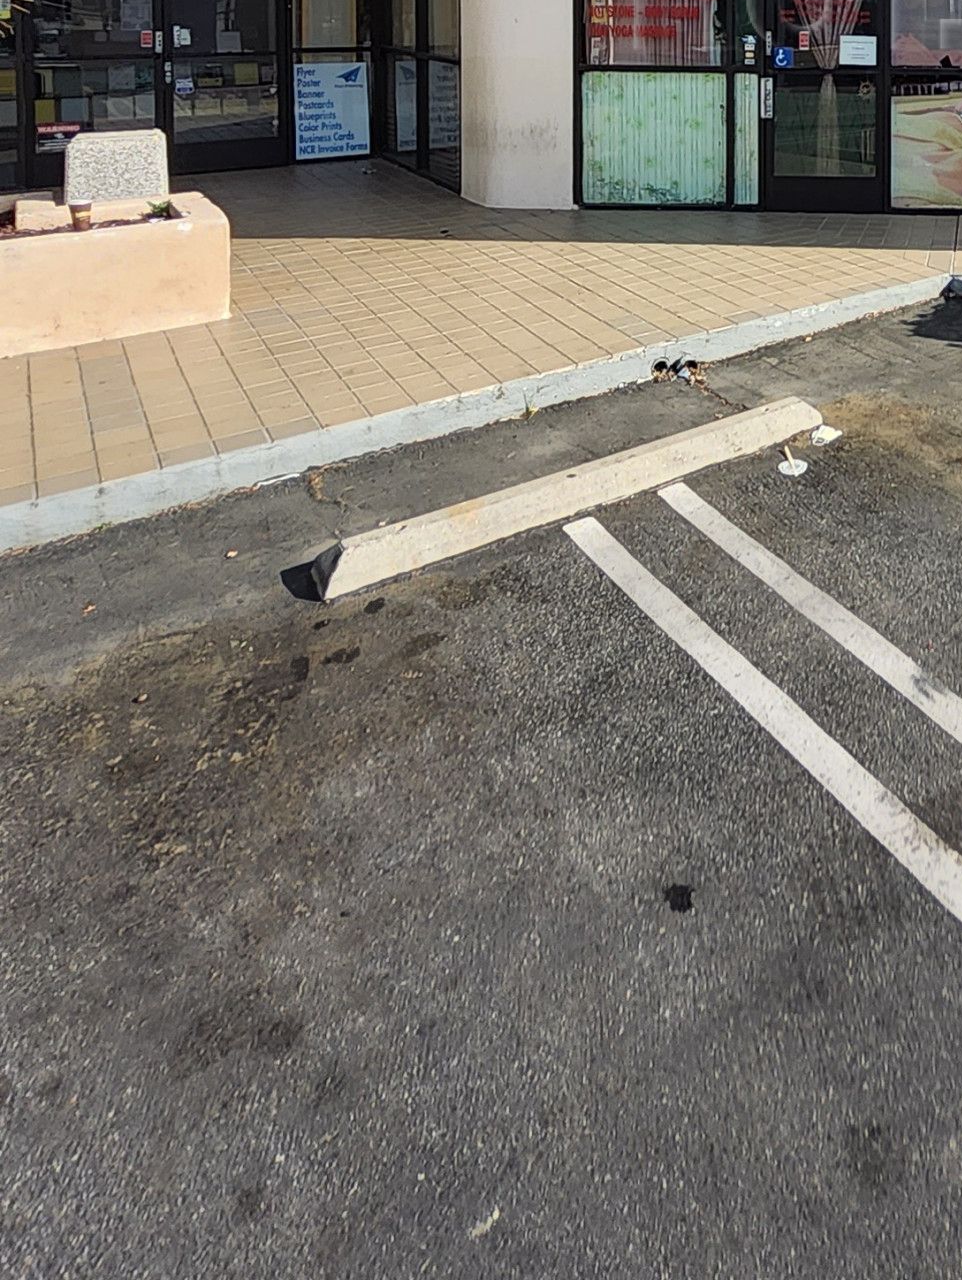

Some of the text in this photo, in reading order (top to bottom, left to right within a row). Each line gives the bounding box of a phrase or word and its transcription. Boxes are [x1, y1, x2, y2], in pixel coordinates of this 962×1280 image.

[297, 67, 315, 78] Flyer
[297, 79, 321, 87] Poster
[297, 90, 325, 98] Banner
[298, 99, 334, 109] Postcards
[298, 111, 336, 122] Blueprints
[298, 121, 342, 132] Color Prints
[299, 131, 355, 143] Business Cards
[317, 143, 344, 153] Invoice
